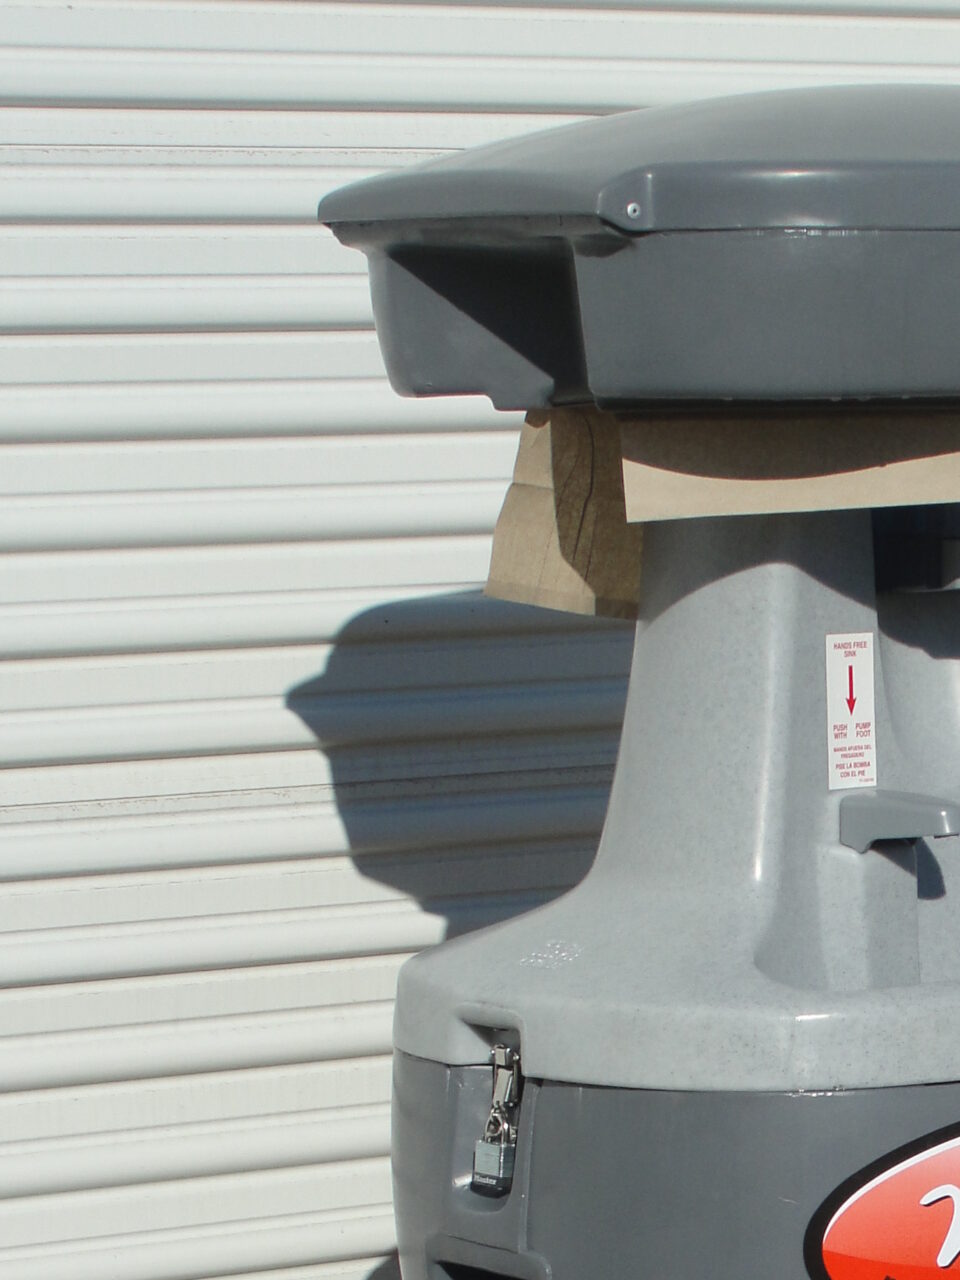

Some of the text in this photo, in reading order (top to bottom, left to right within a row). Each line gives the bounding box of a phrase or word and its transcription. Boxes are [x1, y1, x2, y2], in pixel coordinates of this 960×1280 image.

[853, 641, 867, 649] FREE
[833, 722, 871, 732] PUSH PUMP
[834, 730, 871, 740] WITH FOOT
